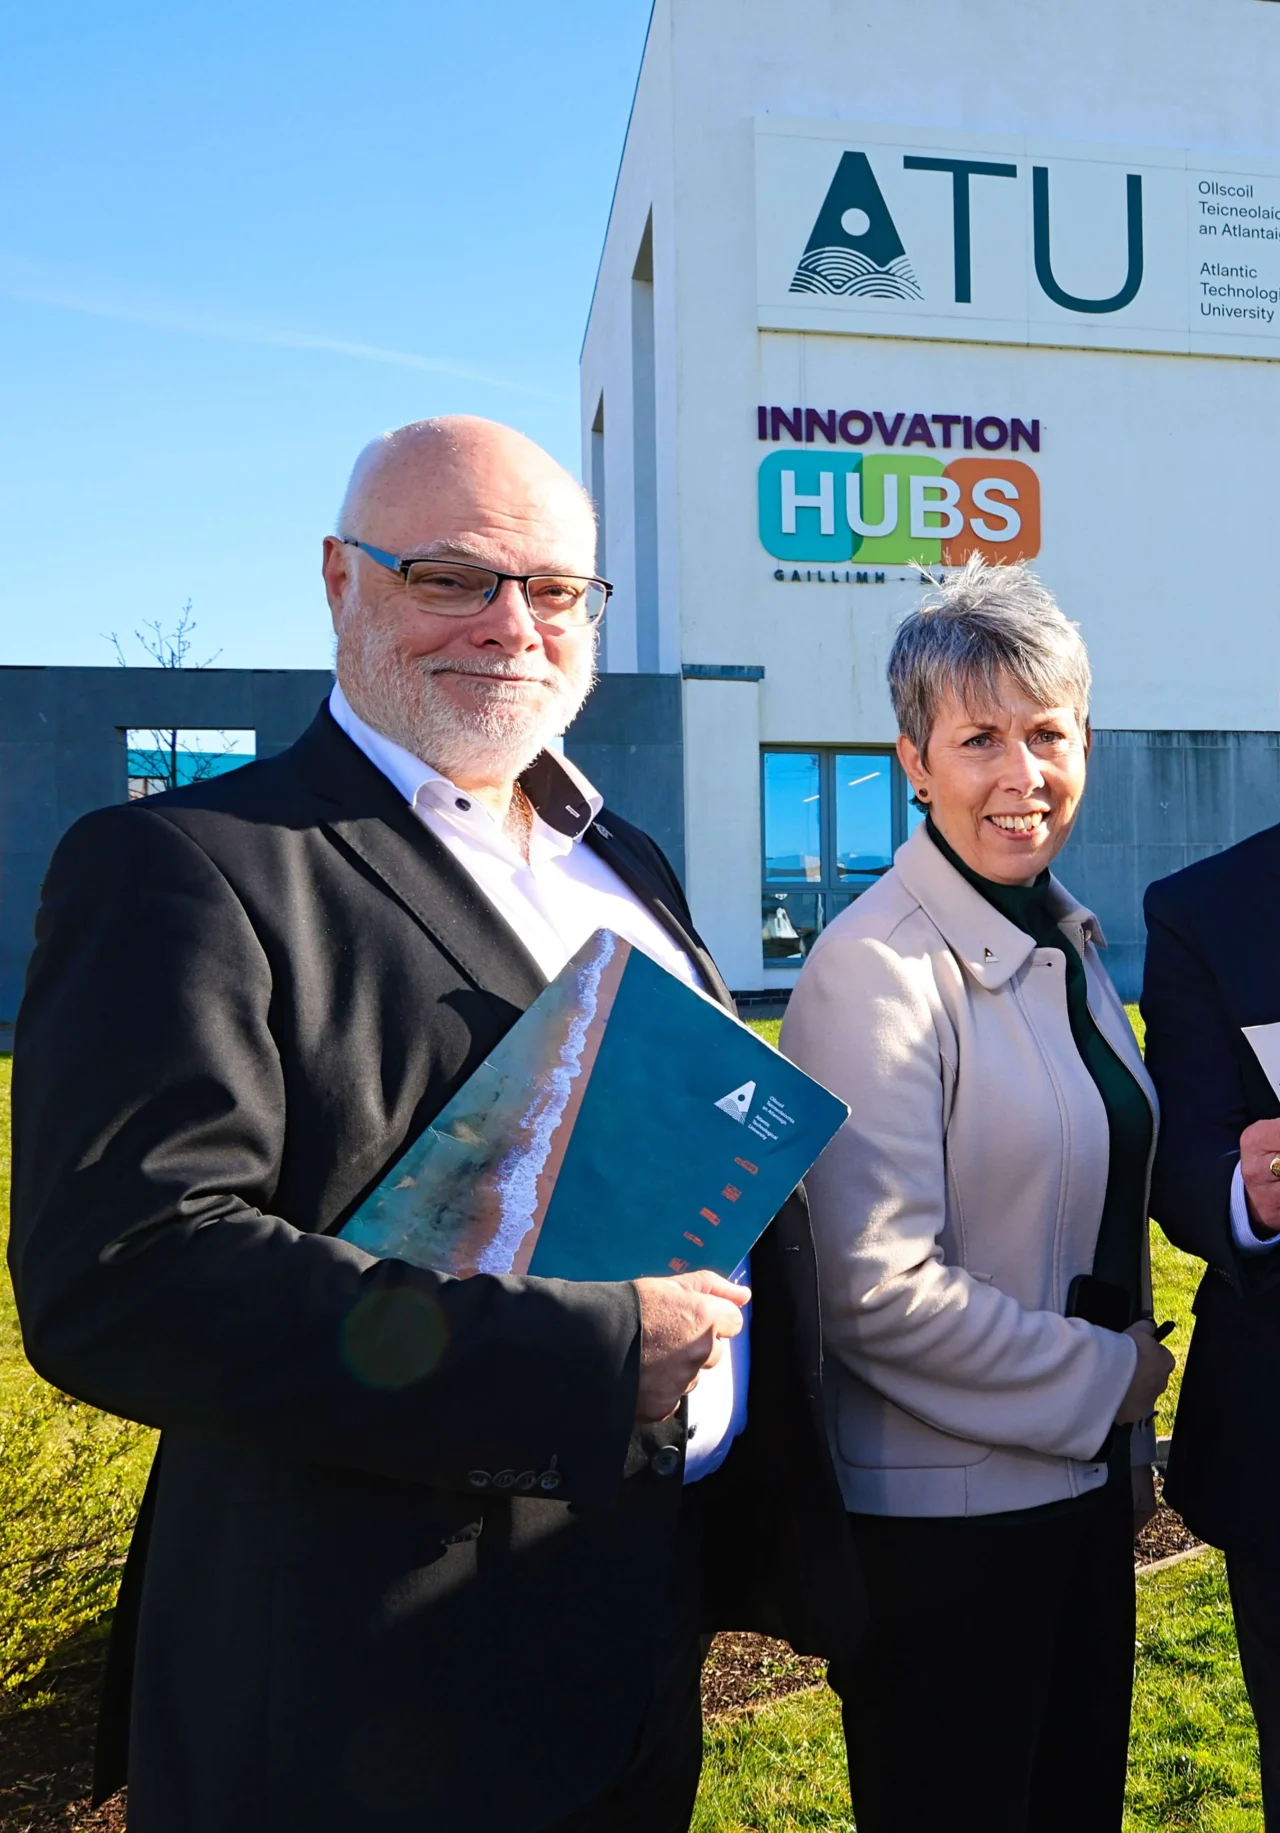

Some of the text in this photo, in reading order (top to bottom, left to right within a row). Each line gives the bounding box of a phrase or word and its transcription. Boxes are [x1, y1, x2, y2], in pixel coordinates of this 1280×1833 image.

[1198, 181, 1253, 198] Ollscoil
[788, 151, 1143, 313] ATU
[1199, 224, 1217, 236] an
[1200, 262, 1258, 279] Atlantic
[1200, 303, 1275, 323] University
[758, 406, 1040, 452] INNOVATION
[781, 470, 1021, 542] HUBS
[774, 569, 885, 584] GAILLIMH
